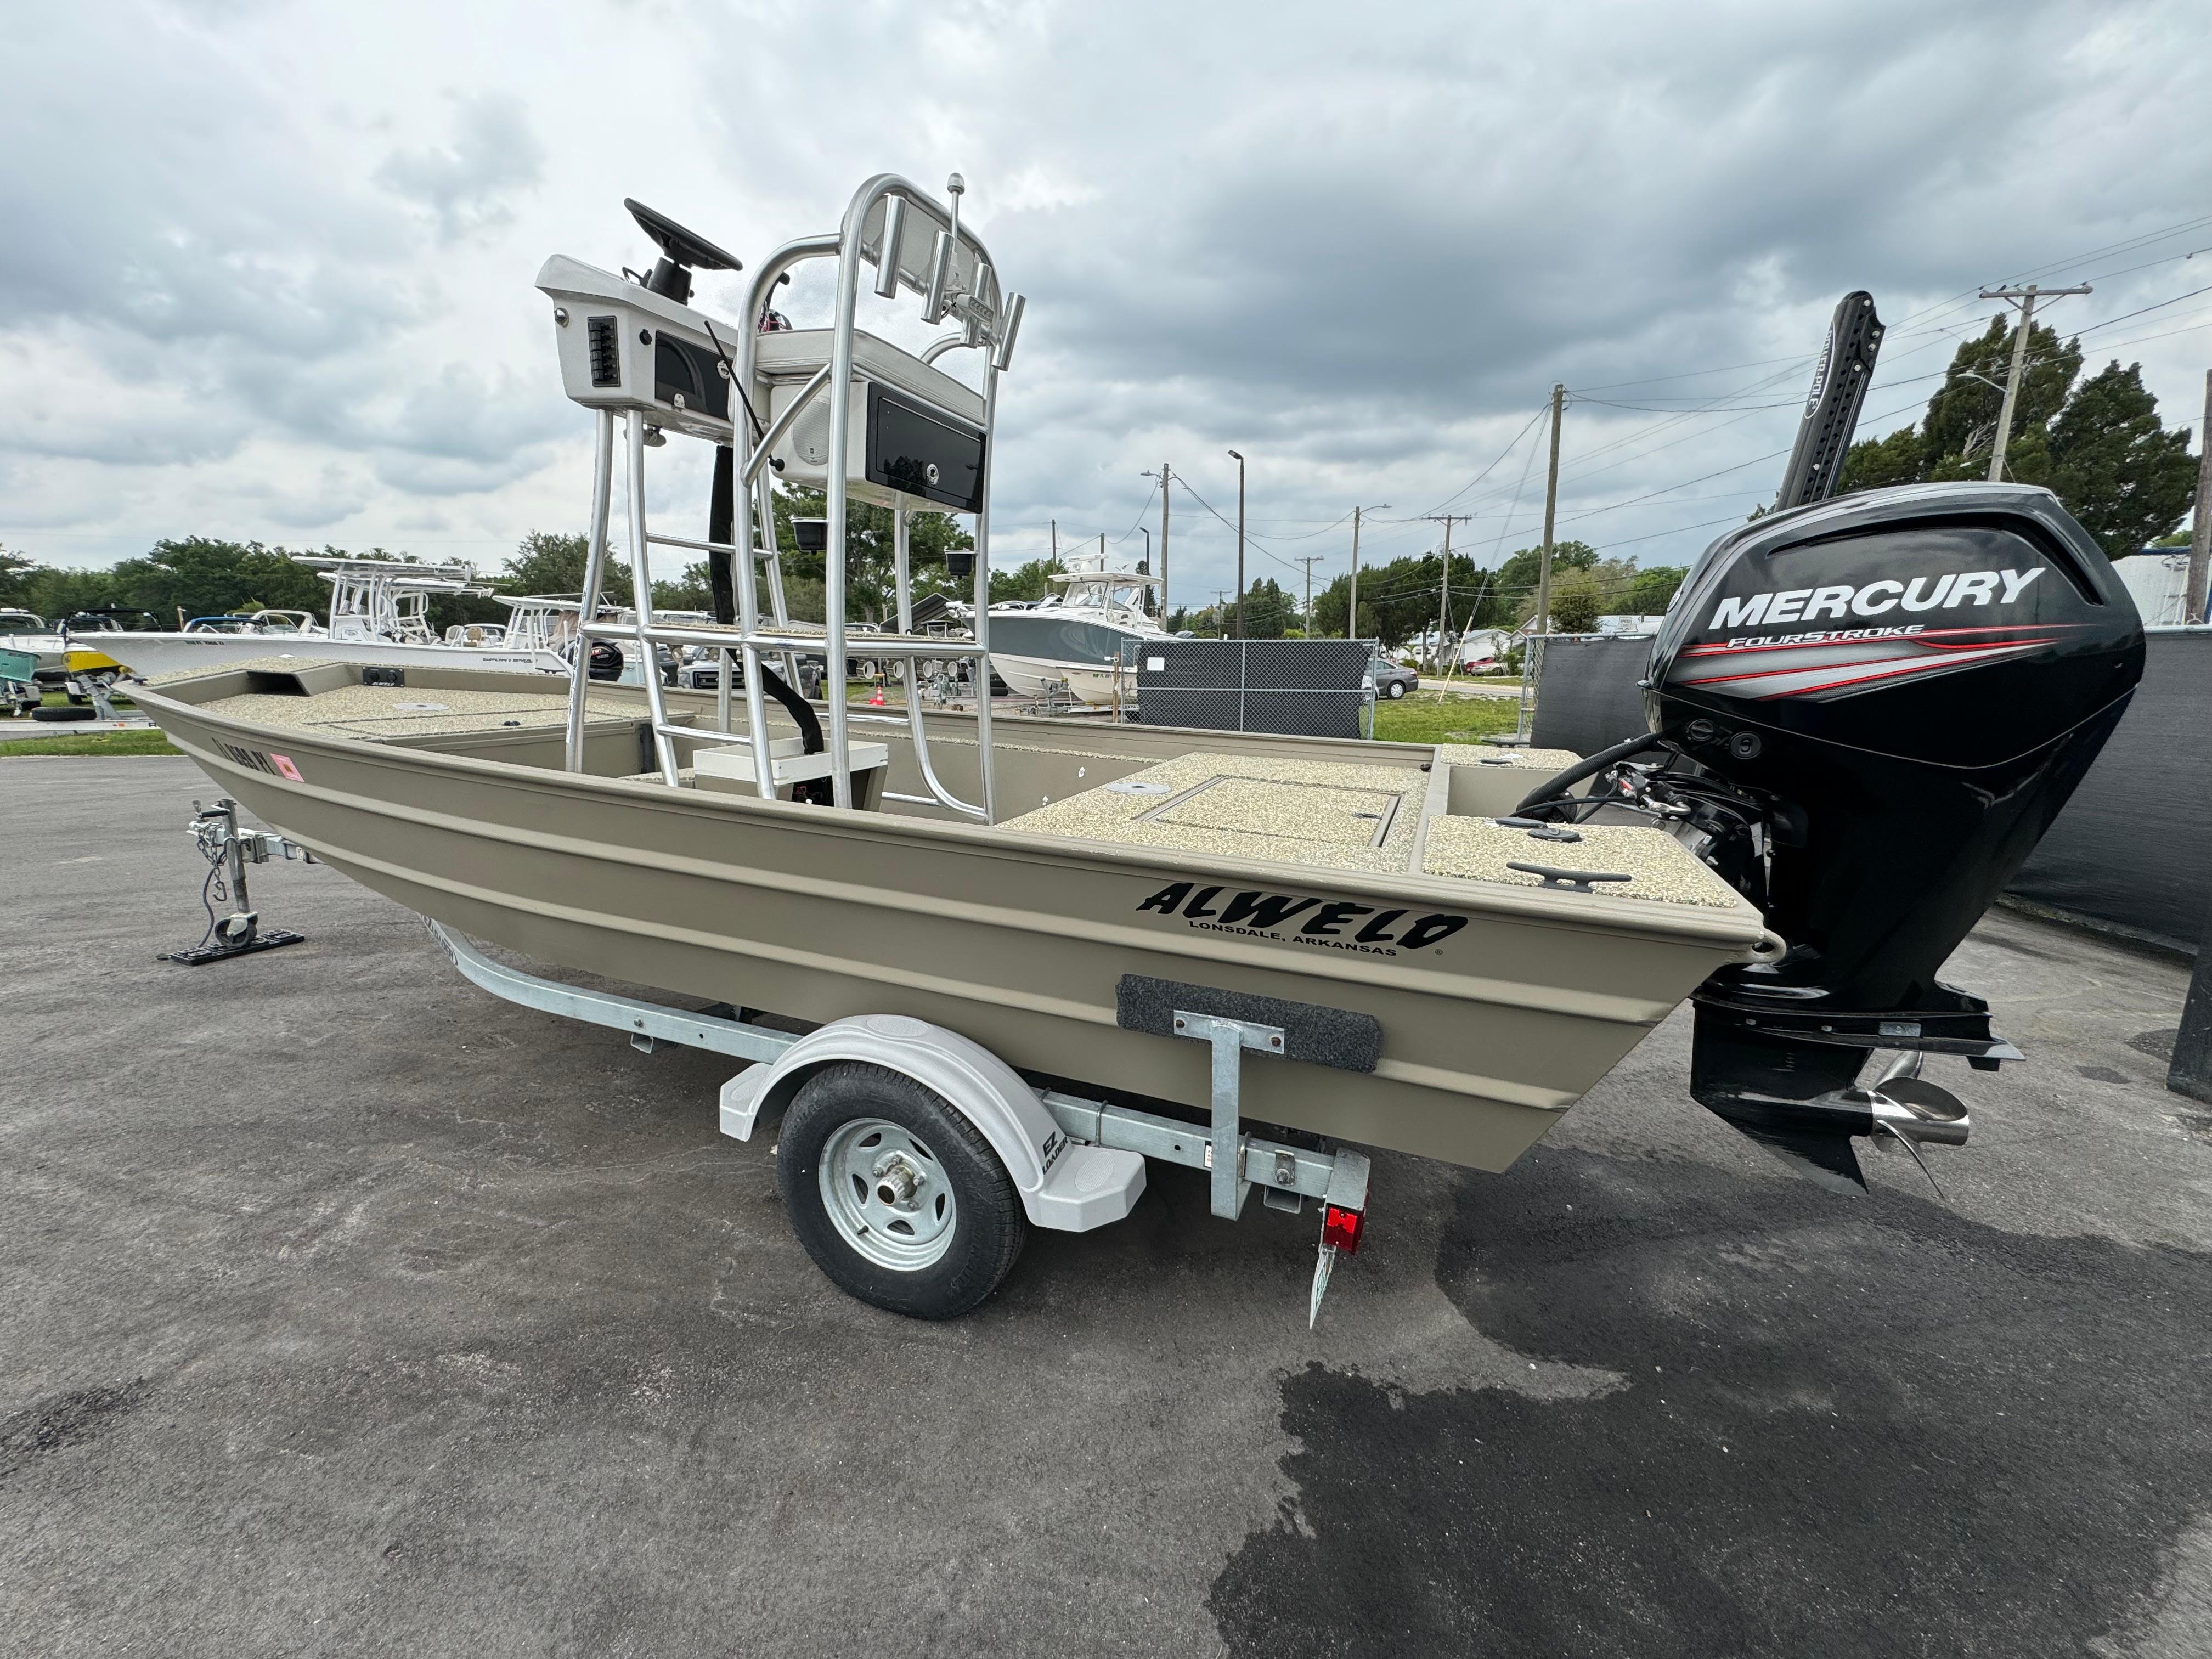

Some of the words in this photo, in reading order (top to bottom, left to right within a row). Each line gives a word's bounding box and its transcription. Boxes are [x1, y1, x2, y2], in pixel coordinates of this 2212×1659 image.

[1809, 330, 1832, 405] POWER-POLE
[1708, 567, 2046, 630] MERCURY
[1726, 624, 1925, 648] FOURSTROKE
[1136, 882, 1469, 949] ALWELD
[1189, 921, 1286, 941] LONSDALE,
[1292, 935, 1397, 956] ARKANSAS
[1042, 1131, 1058, 1158] EZ
[1042, 1136, 1068, 1175] LOADER
